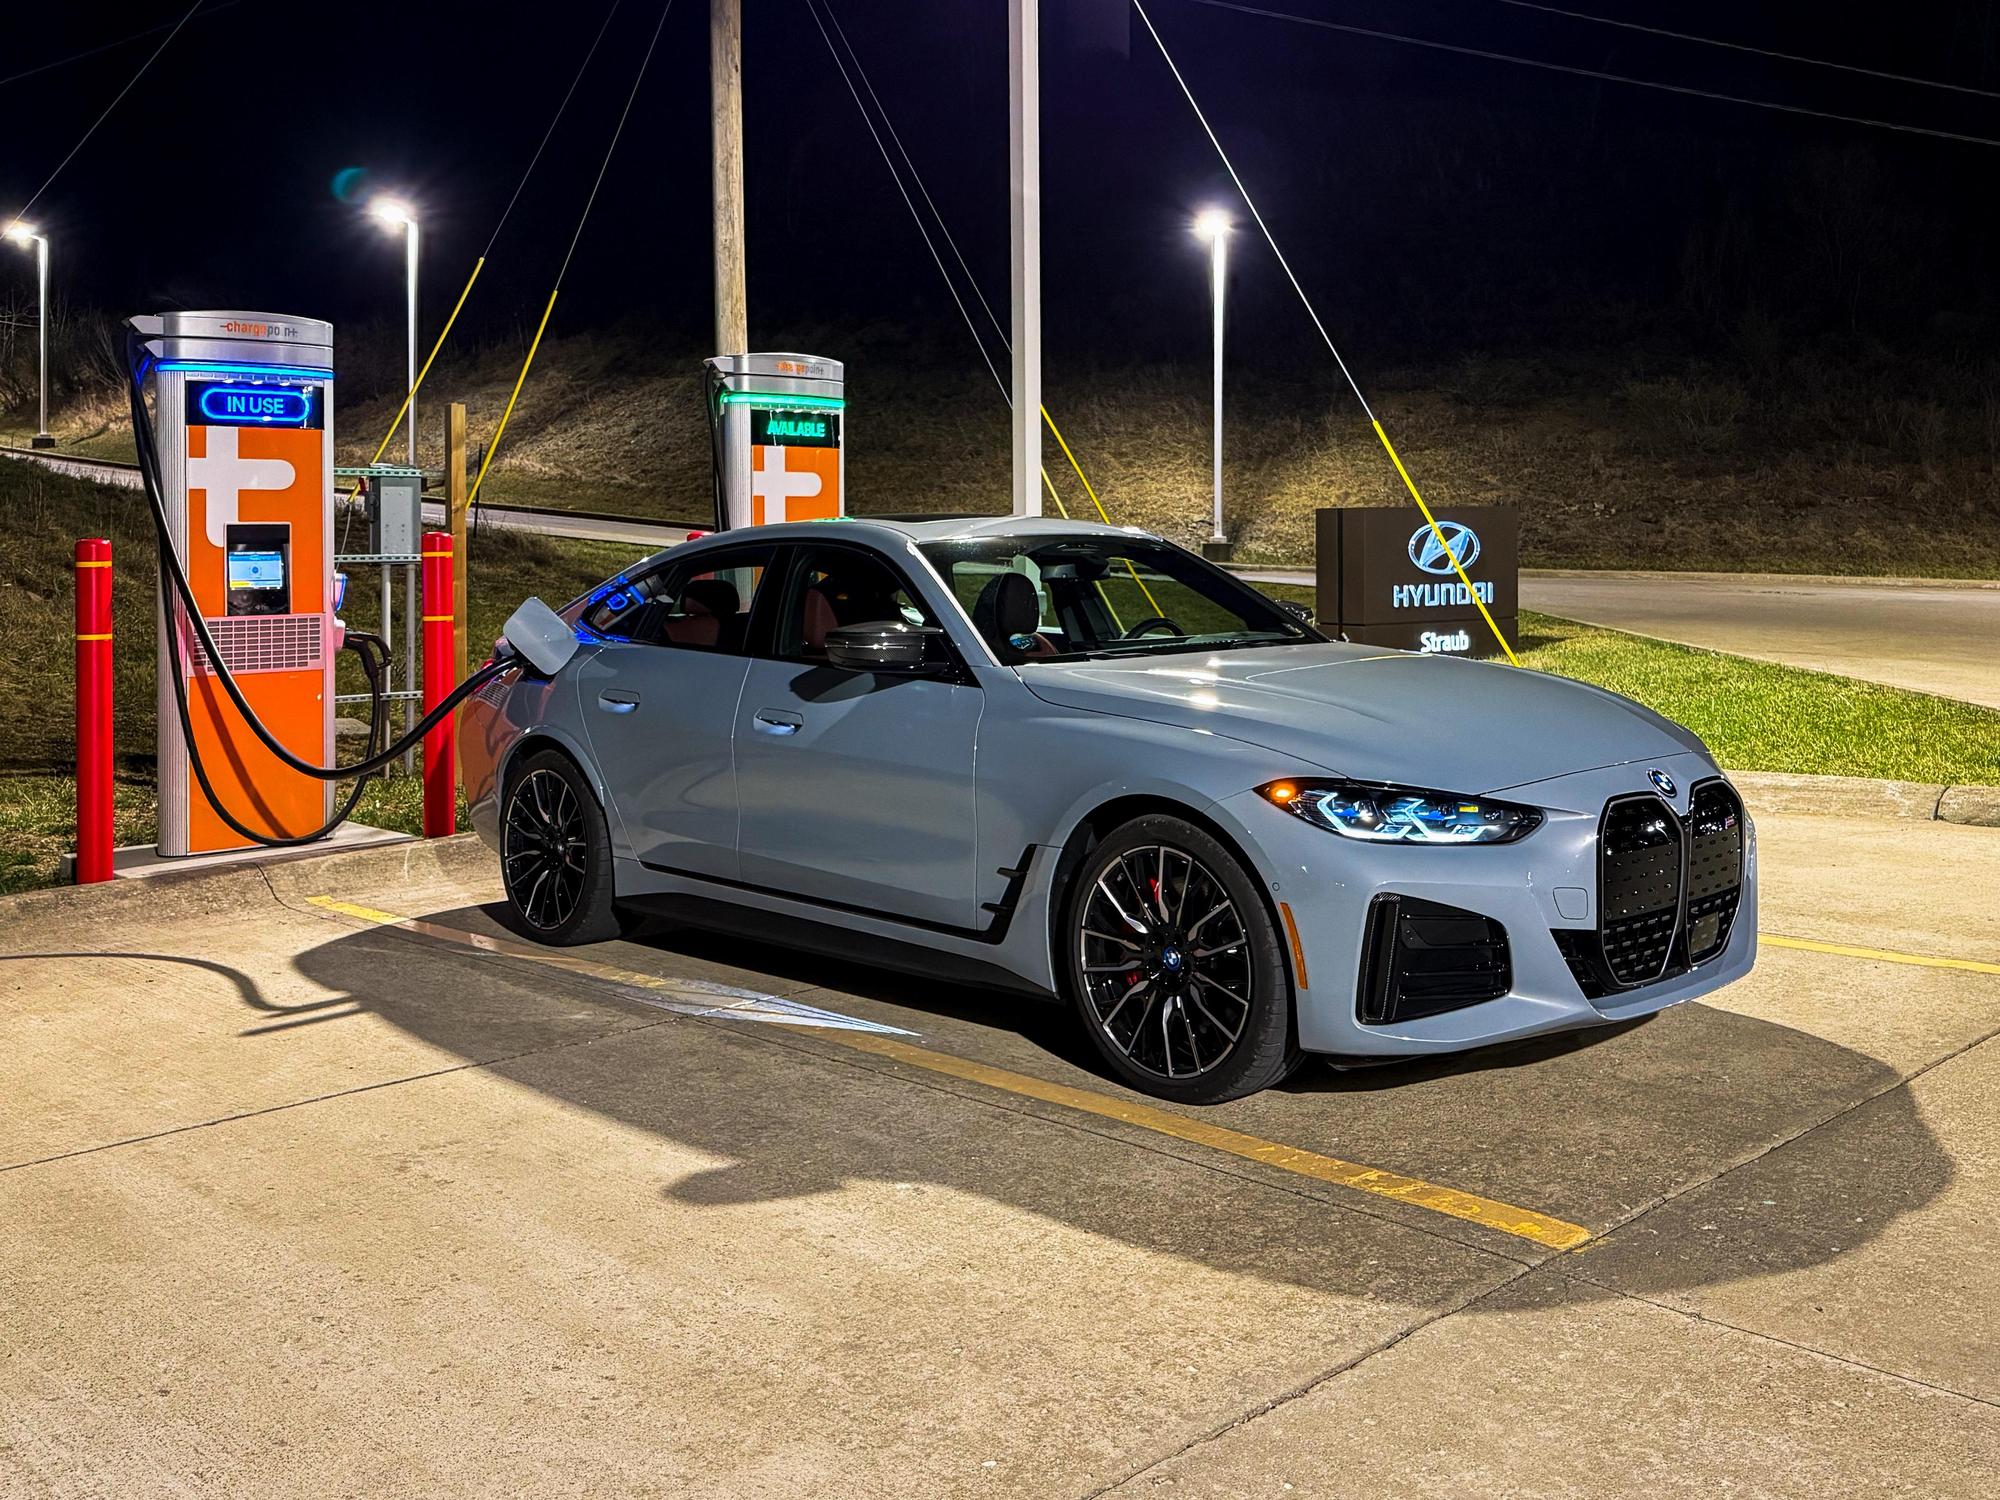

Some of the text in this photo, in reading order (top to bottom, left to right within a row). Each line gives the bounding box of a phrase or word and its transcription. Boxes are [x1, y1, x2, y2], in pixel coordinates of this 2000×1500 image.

[221, 321, 298, 337] chargepont
[227, 396, 284, 415] IN USE
[767, 421, 826, 438] AVAILABLE
[1393, 582, 1494, 608] HYUNDAI
[1420, 630, 1469, 653] Straub
